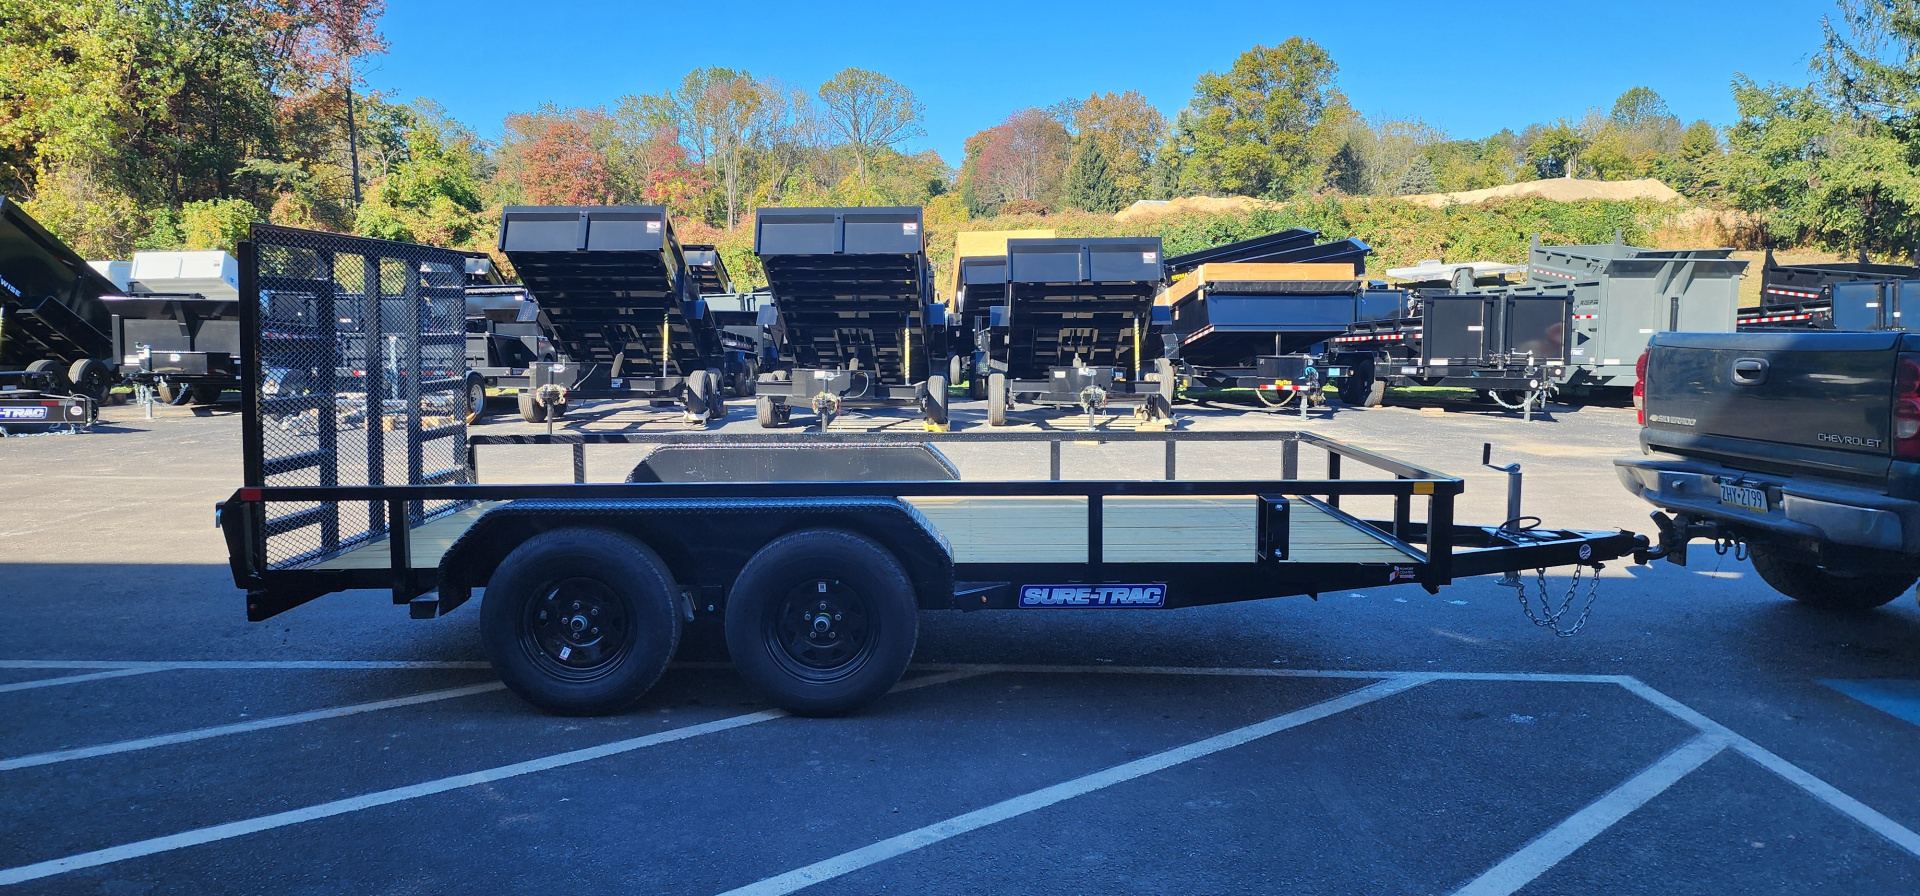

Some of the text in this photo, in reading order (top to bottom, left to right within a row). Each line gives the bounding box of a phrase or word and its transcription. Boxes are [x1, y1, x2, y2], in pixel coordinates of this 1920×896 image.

[0, 275, 21, 297] WISE
[1817, 433, 1882, 448] CHEVROLET
[1023, 587, 1162, 605] SURE-TRAC
